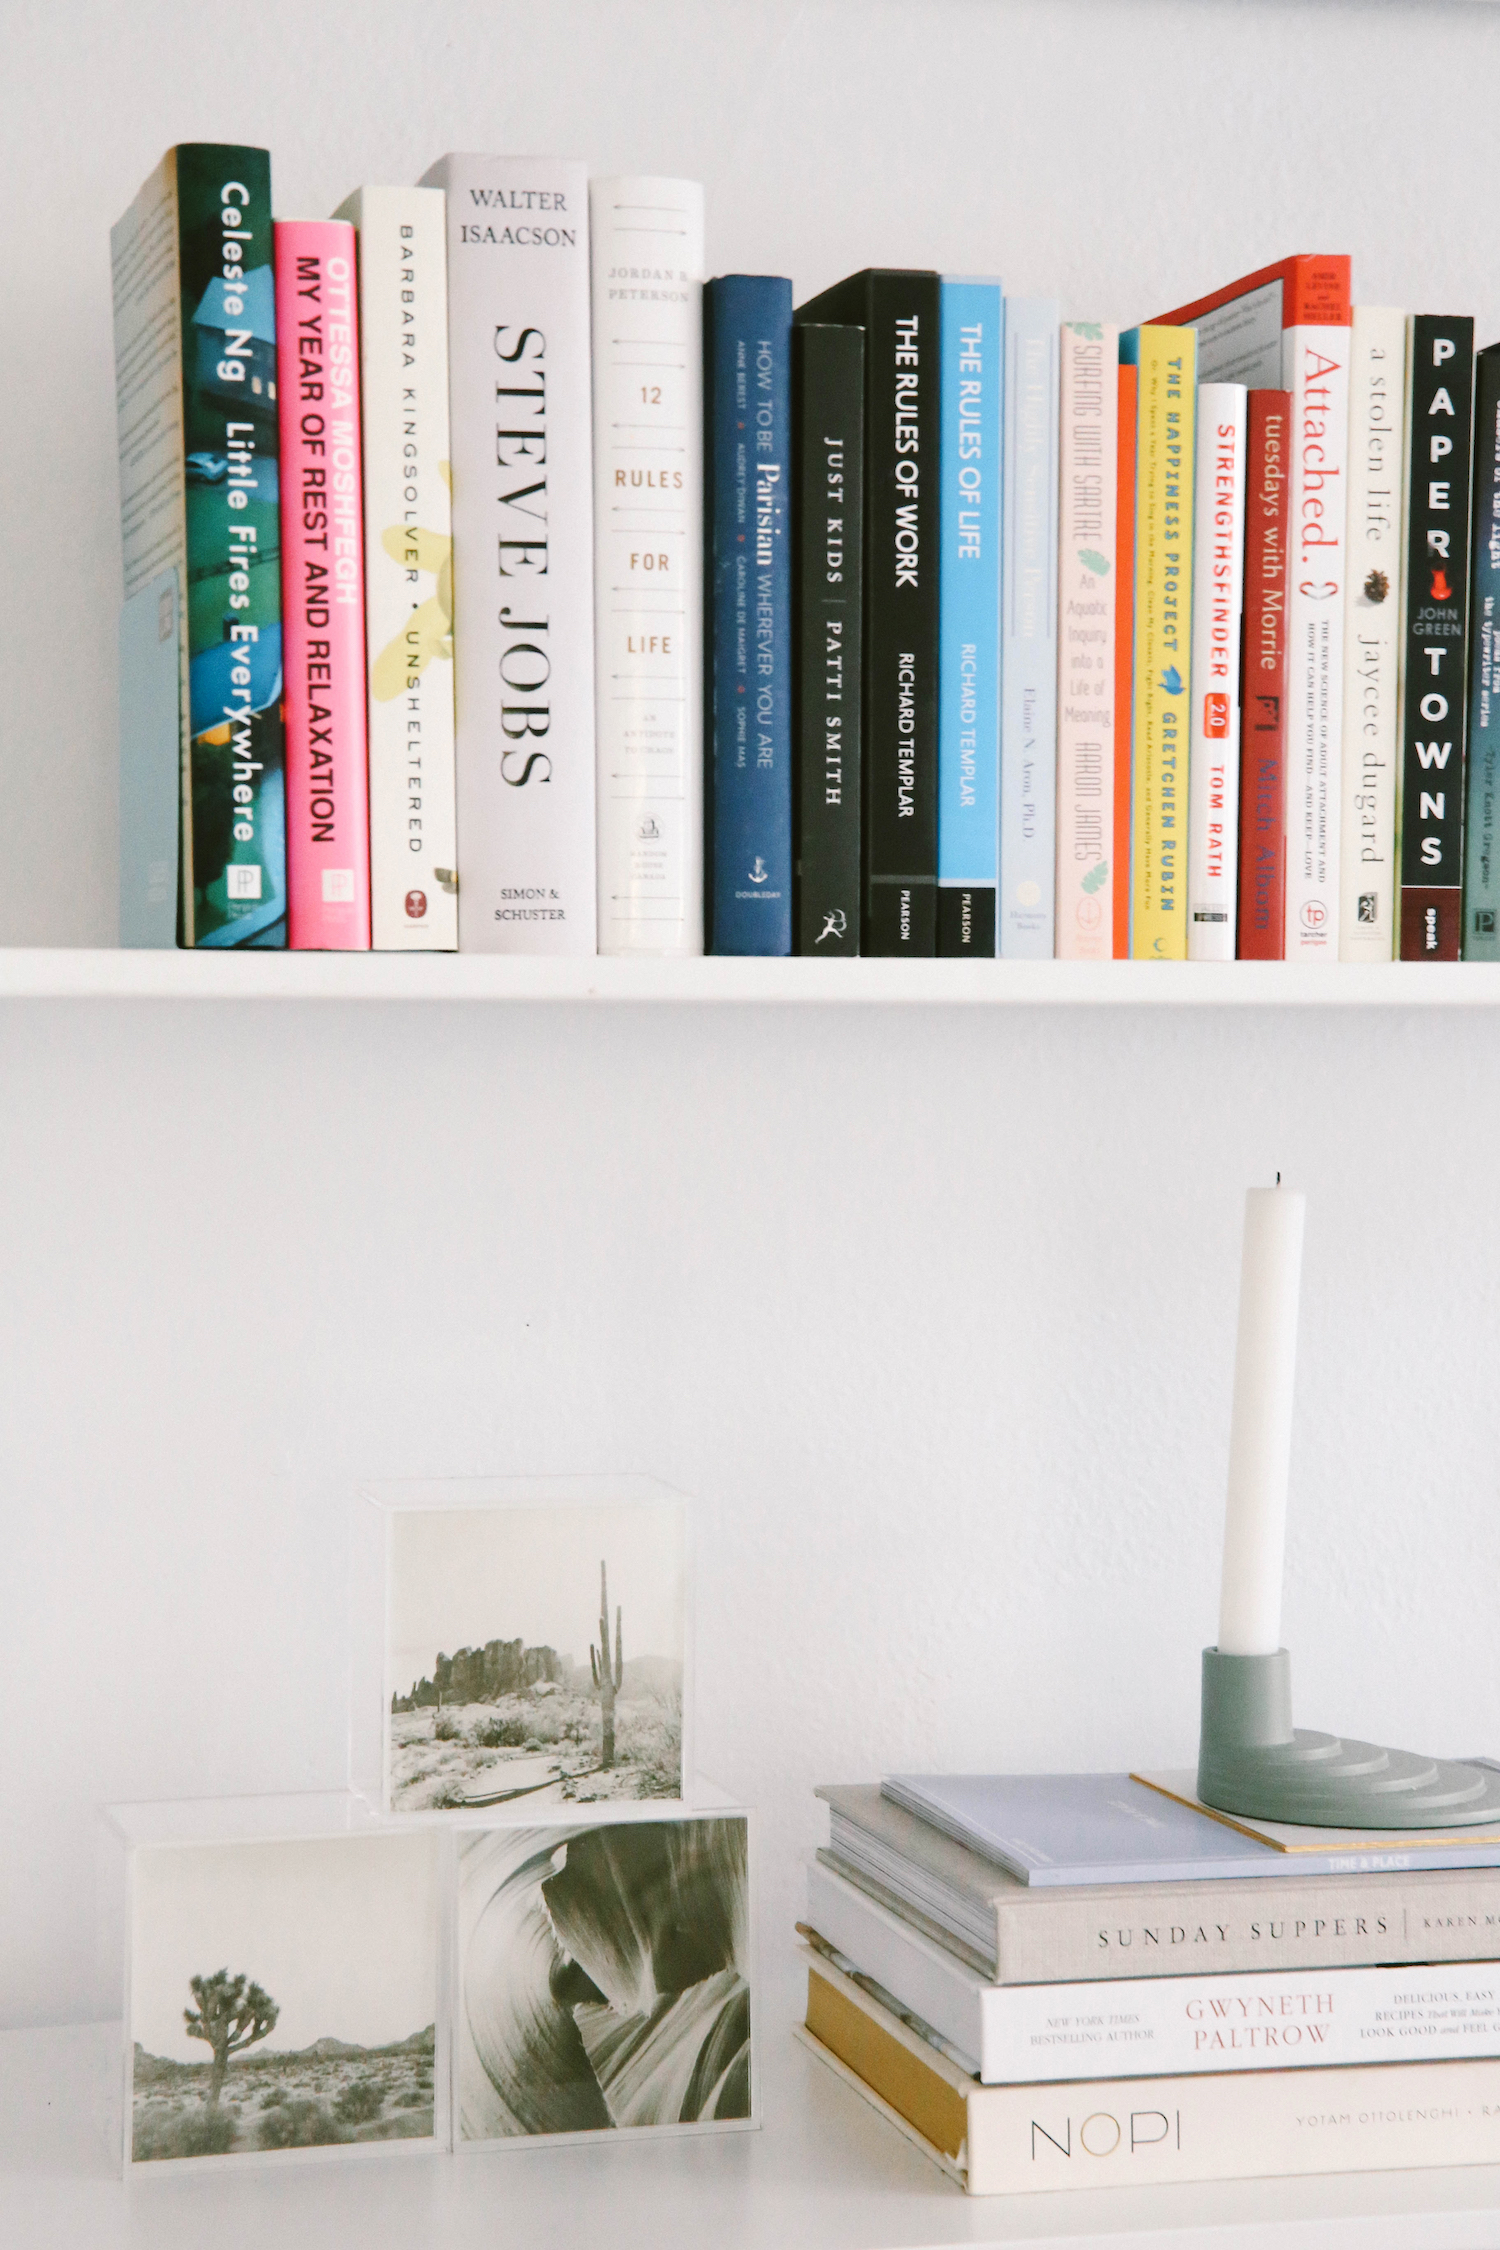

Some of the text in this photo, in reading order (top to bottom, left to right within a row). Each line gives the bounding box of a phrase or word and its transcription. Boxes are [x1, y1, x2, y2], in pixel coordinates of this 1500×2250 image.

[470, 189, 567, 211] WALTER
[460, 225, 577, 247] ISAACSON
[216, 181, 254, 382] Celeste Ng
[608, 267, 673, 281] JORDAN
[608, 288, 690, 303] PETERSON
[641, 387, 662, 405] 12
[736, 340, 746, 410] ANNE BEREST
[400, 225, 419, 582] BARBARA KINGSOLVER
[327, 257, 358, 604] OTTESSA MOSHFEGH
[895, 315, 919, 587] THE RULES OF WORK
[957, 322, 982, 559] THE RULES OF LIFE
[1072, 344, 1103, 541] SURFING WITH SARTRE
[1301, 348, 1342, 563] Attached.
[1366, 348, 1393, 541] a stolen life
[1427, 338, 1456, 558] PAPER
[615, 470, 683, 489] RULES
[736, 443, 746, 484] AUDREY
[824, 436, 844, 583] JUST KIDS
[1163, 358, 1182, 652] THE HAPPINESS PROJECT
[297, 257, 335, 843] MY YEAR OF REST AND RELAXATION
[493, 325, 552, 787] STEVE JOBS
[630, 553, 670, 572] FOR
[756, 340, 781, 769] HOW TO BE Parisian WHEREVER YOU ARE
[1211, 424, 1236, 677] STRENGTHSFINDER
[1259, 415, 1284, 670] tuesdays with Morrie
[223, 422, 263, 842] Little Fires Everywhere
[736, 556, 746, 674] CAROLINE DE MAIGRET
[1306, 623, 1315, 649] HOW
[1412, 623, 1462, 637] GREEN
[1416, 607, 1458, 621] JOHN
[627, 636, 672, 654] LIFE
[1306, 652, 1315, 663] IT
[1480, 596, 1495, 728] the typewriter series
[1305, 667, 1315, 690] CAN
[736, 706, 746, 742] SOPHIE
[825, 621, 842, 805] PATTI SMITH
[959, 643, 977, 808] RICHARD TEMPLAR
[1022, 688, 1036, 733] Elaine
[1304, 692, 1314, 721] HELP
[405, 630, 422, 853] UNSHELTERED
[898, 652, 915, 818] RICHARD TEMPLAR
[1304, 723, 1314, 746] YOU
[1317, 620, 1329, 883] THE NEW SCIENCE OF ADULT ATTACHMENT AND
[1354, 634, 1388, 863] jaycee dugard
[1414, 647, 1452, 866] TOWNS
[1073, 741, 1103, 861] AARON JAMES
[1160, 712, 1177, 911] GRETCHEN RUBIN
[1207, 765, 1225, 878] TOM RATH
[1254, 759, 1279, 930] Mitch Albom
[494, 909, 565, 921] SCHUSTER
[500, 888, 560, 901] SIMON &
[735, 891, 781, 899] DOUBLEDAY
[900, 890, 911, 940] PEARSON
[961, 893, 971, 943] PEARSON
[1425, 907, 1438, 950] speak
[1328, 1856, 1357, 1870] TIME
[1372, 1855, 1411, 1869] PLACE
[1098, 1915, 1389, 1949] SUNDAY SUPPERS
[1423, 1915, 1477, 1929] KAREN
[1186, 1993, 1336, 2021] GWYNETH
[1375, 2010, 1424, 2021] RECIPES
[1465, 1990, 1496, 2001] EASY
[1029, 2029, 1155, 2046] BESTSELLING AUTHOR
[1046, 2014, 1141, 2028] NEW YORK TIMES
[1193, 2023, 1331, 2052] PALTROW
[1360, 2027, 1395, 2039] LOOK
[1399, 2025, 1437, 2037] GOOD
[1463, 2022, 1487, 2034] FEEL
[1031, 2109, 1182, 2161] NOPI
[1296, 2107, 1459, 2127] YOTAM OTTOLENGHI
